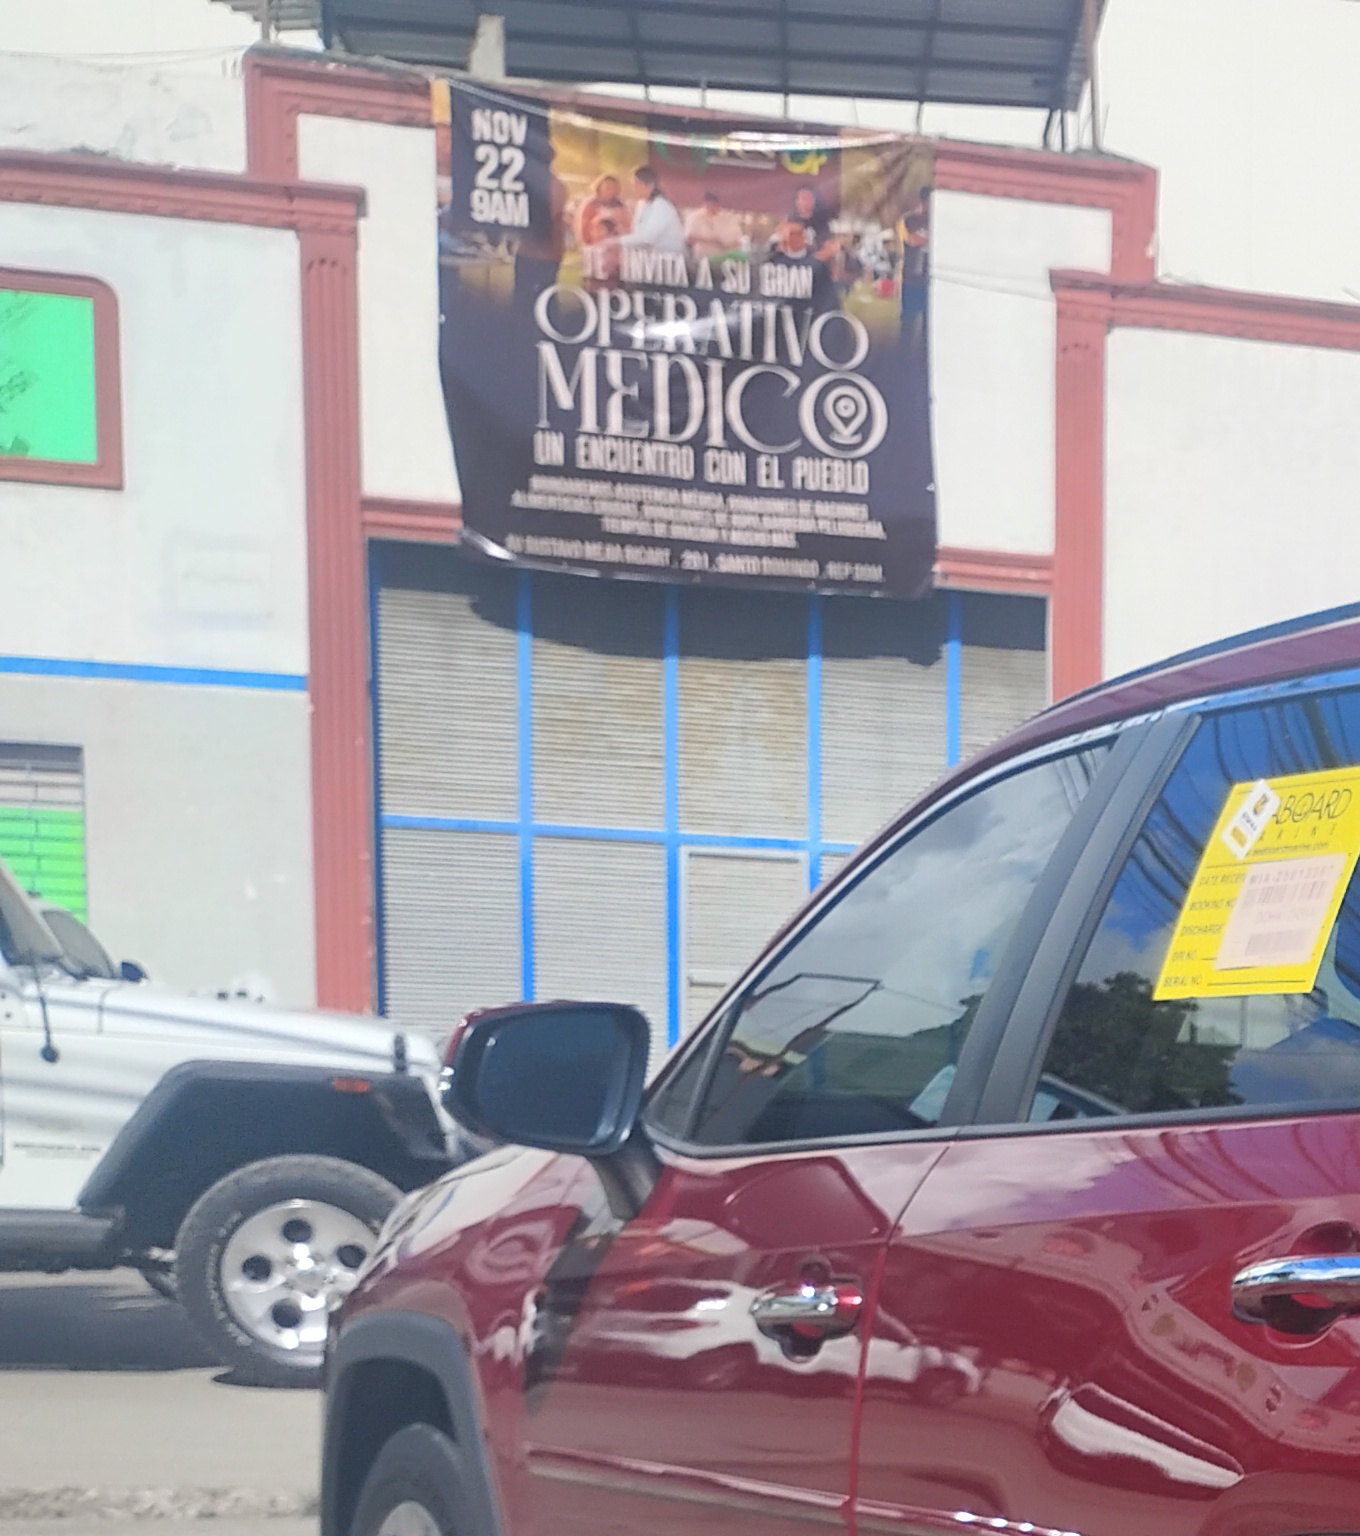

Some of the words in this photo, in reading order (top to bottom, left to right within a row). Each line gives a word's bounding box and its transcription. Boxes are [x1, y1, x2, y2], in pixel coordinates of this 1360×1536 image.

[471, 107, 528, 146] NOV
[475, 144, 525, 191] 22
[470, 188, 530, 228] 9AM
[620, 248, 688, 288] INVITA
[695, 257, 713, 291] A
[721, 258, 750, 295] SU
[760, 262, 813, 299] GRAN
[534, 283, 870, 371] OPERATIVO
[534, 340, 889, 459] MEDICO
[533, 430, 565, 466] UN
[575, 434, 695, 481] ENCUENTRO
[703, 449, 746, 486] CON
[757, 453, 785, 489] EL
[792, 456, 870, 495] PUEBLO
